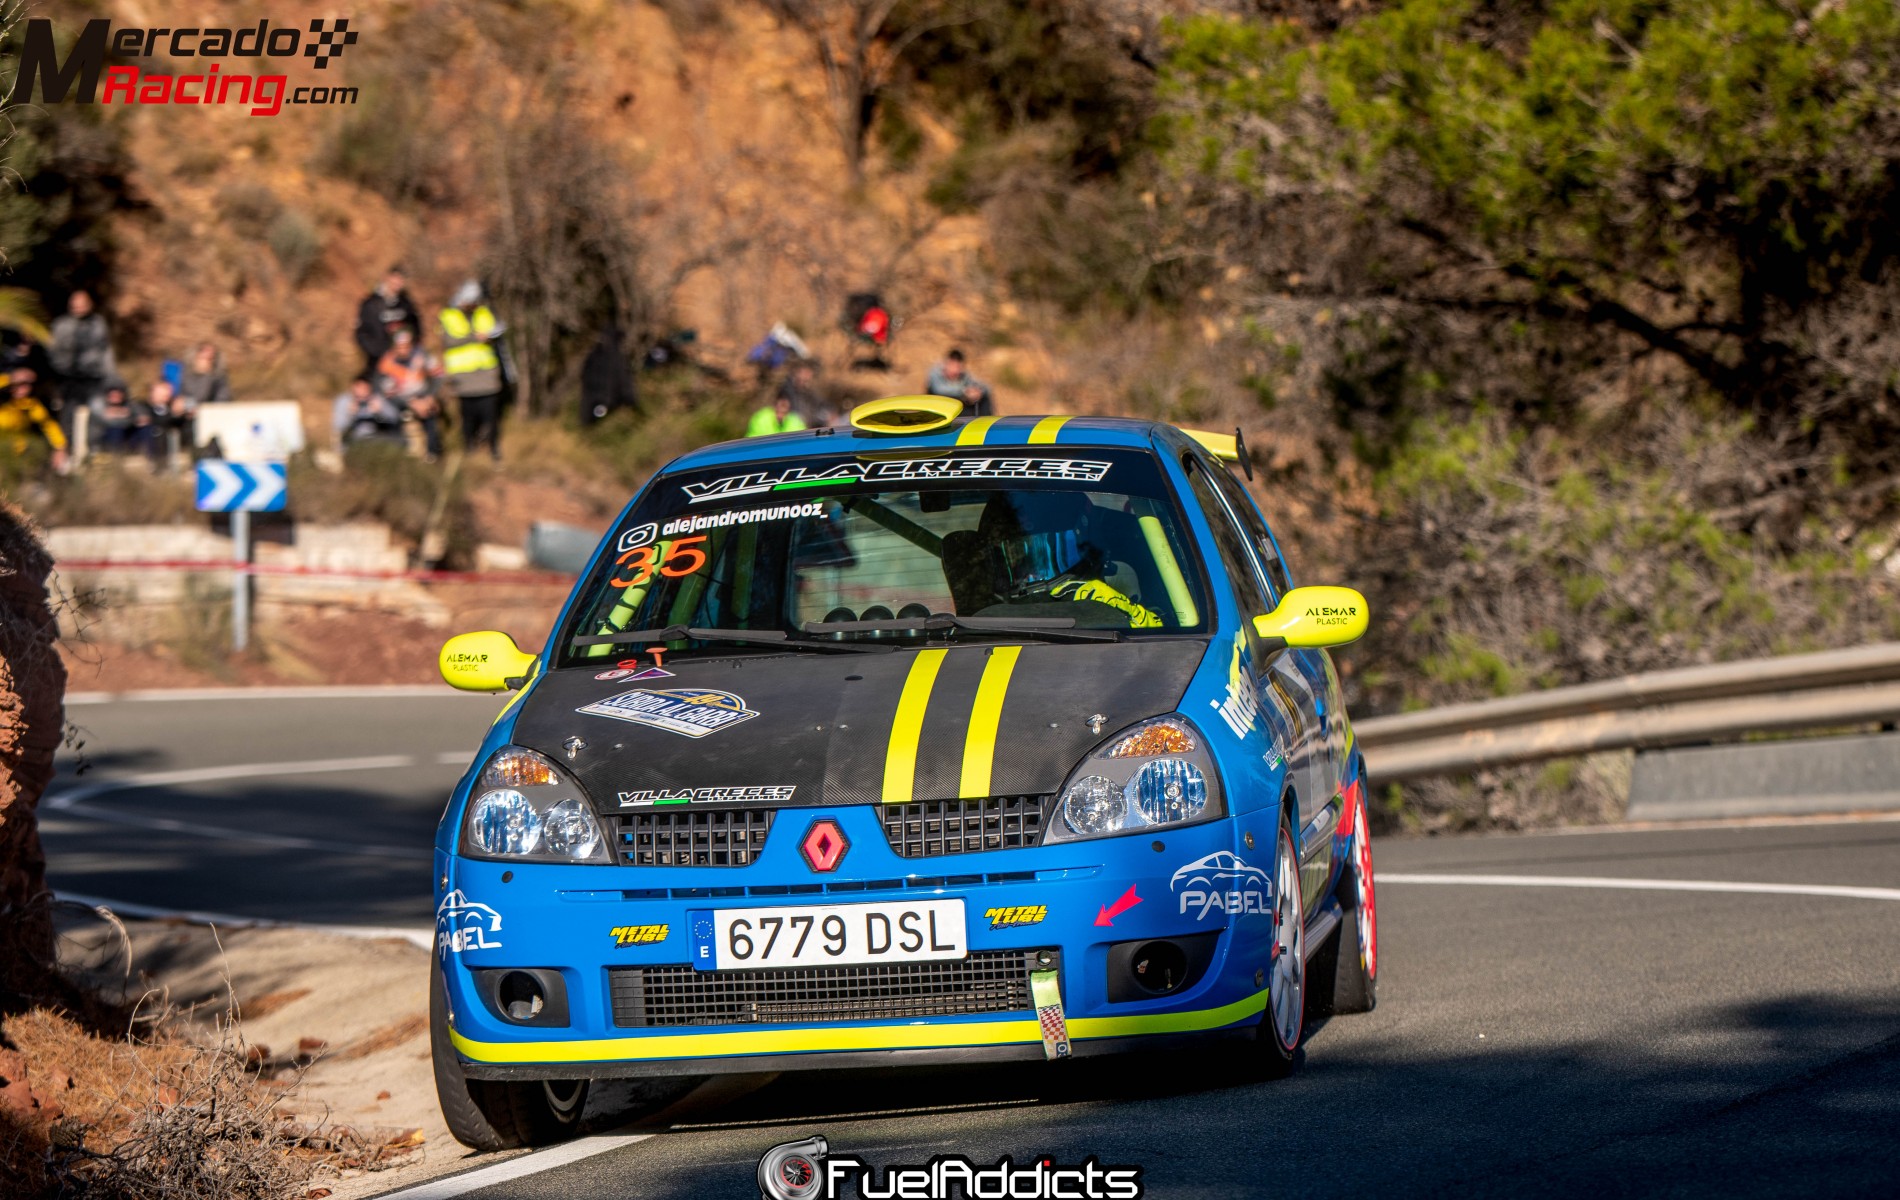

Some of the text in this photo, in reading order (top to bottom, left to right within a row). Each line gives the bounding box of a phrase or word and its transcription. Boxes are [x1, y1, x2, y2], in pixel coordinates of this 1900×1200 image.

[610, 535, 707, 588] 35
[1305, 607, 1357, 617] ALEMAR
[1316, 617, 1348, 625] PLASTIC
[446, 653, 488, 663] ALEMAR
[453, 664, 479, 672] PLASTIC
[984, 905, 1048, 918] METAL
[1179, 890, 1273, 921] PABEL
[991, 913, 1046, 925] LUBE
[609, 924, 670, 937] METAL
[728, 909, 956, 960] 6779 DSL
[438, 926, 503, 961] PABEL
[616, 933, 668, 944] LUBE
[699, 945, 710, 958] E
